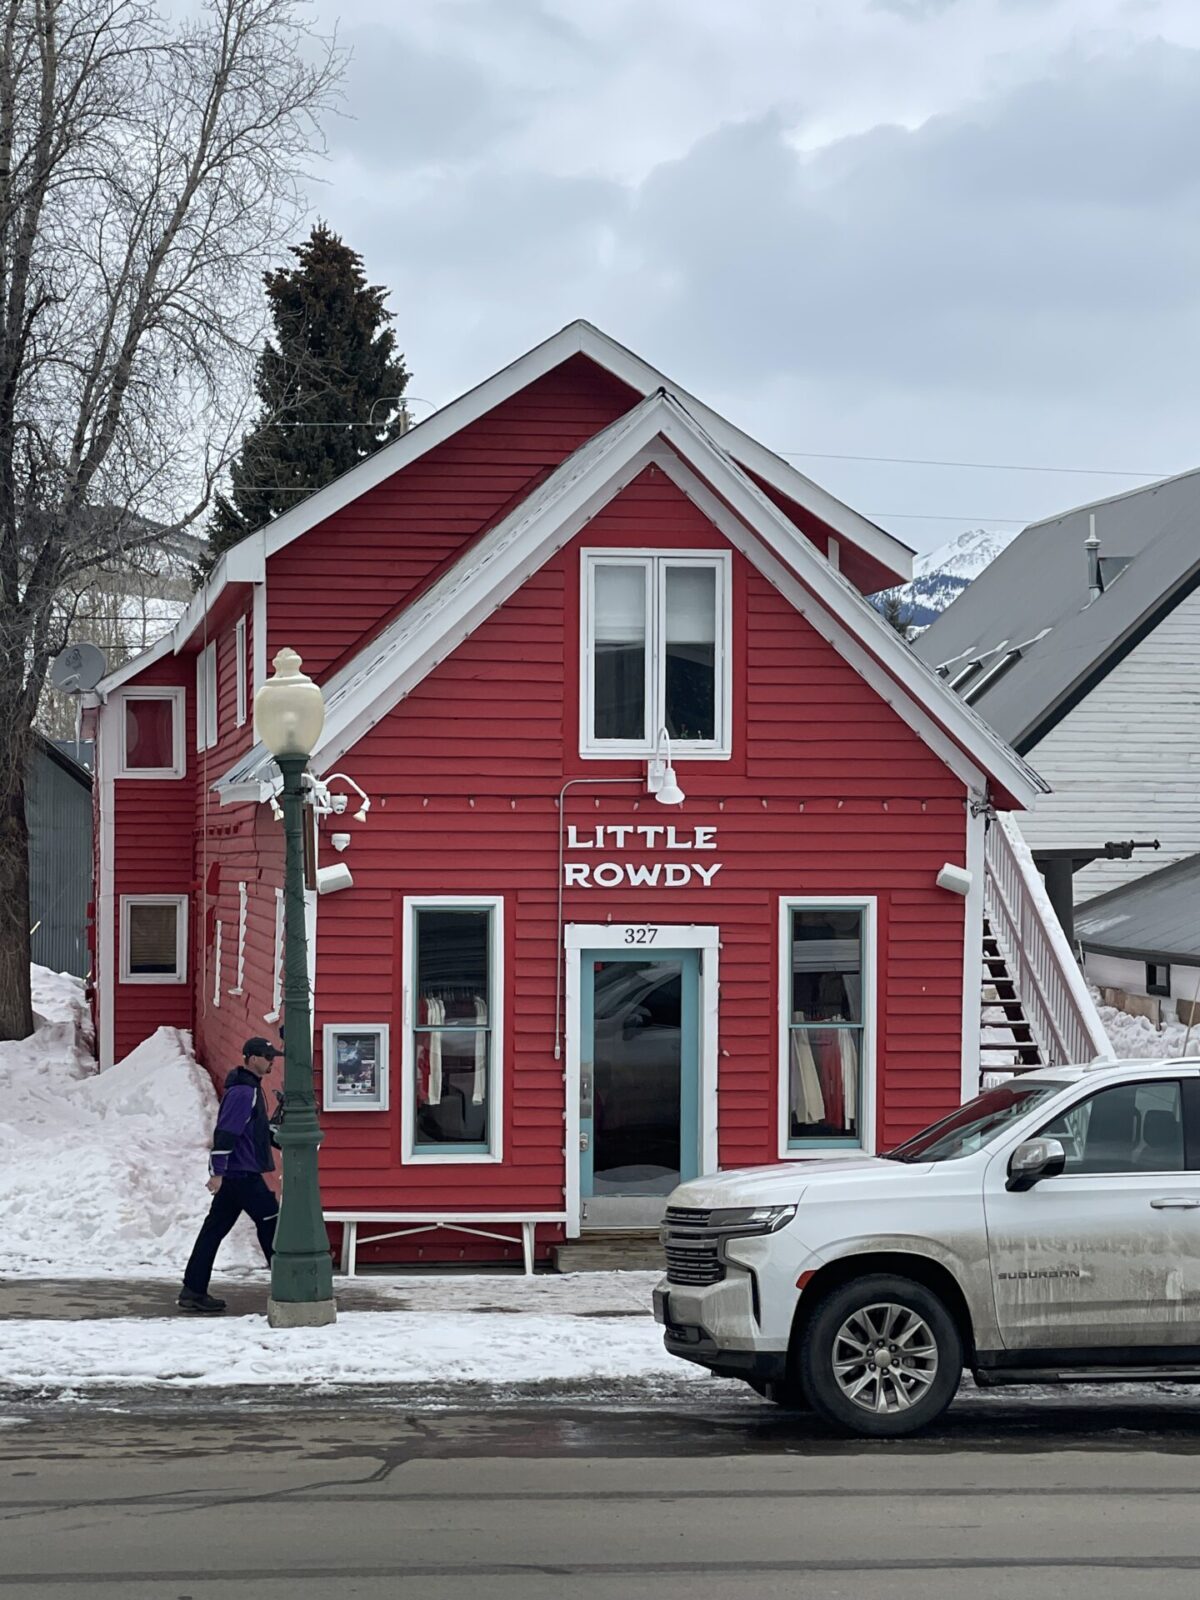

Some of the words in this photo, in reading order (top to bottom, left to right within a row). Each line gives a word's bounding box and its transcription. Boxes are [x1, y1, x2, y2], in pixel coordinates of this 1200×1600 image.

[567, 825, 717, 848] LITTLE
[564, 862, 723, 888] ROWDY
[624, 928, 658, 944] 327
[998, 1270, 1080, 1280] SUBURBAN
